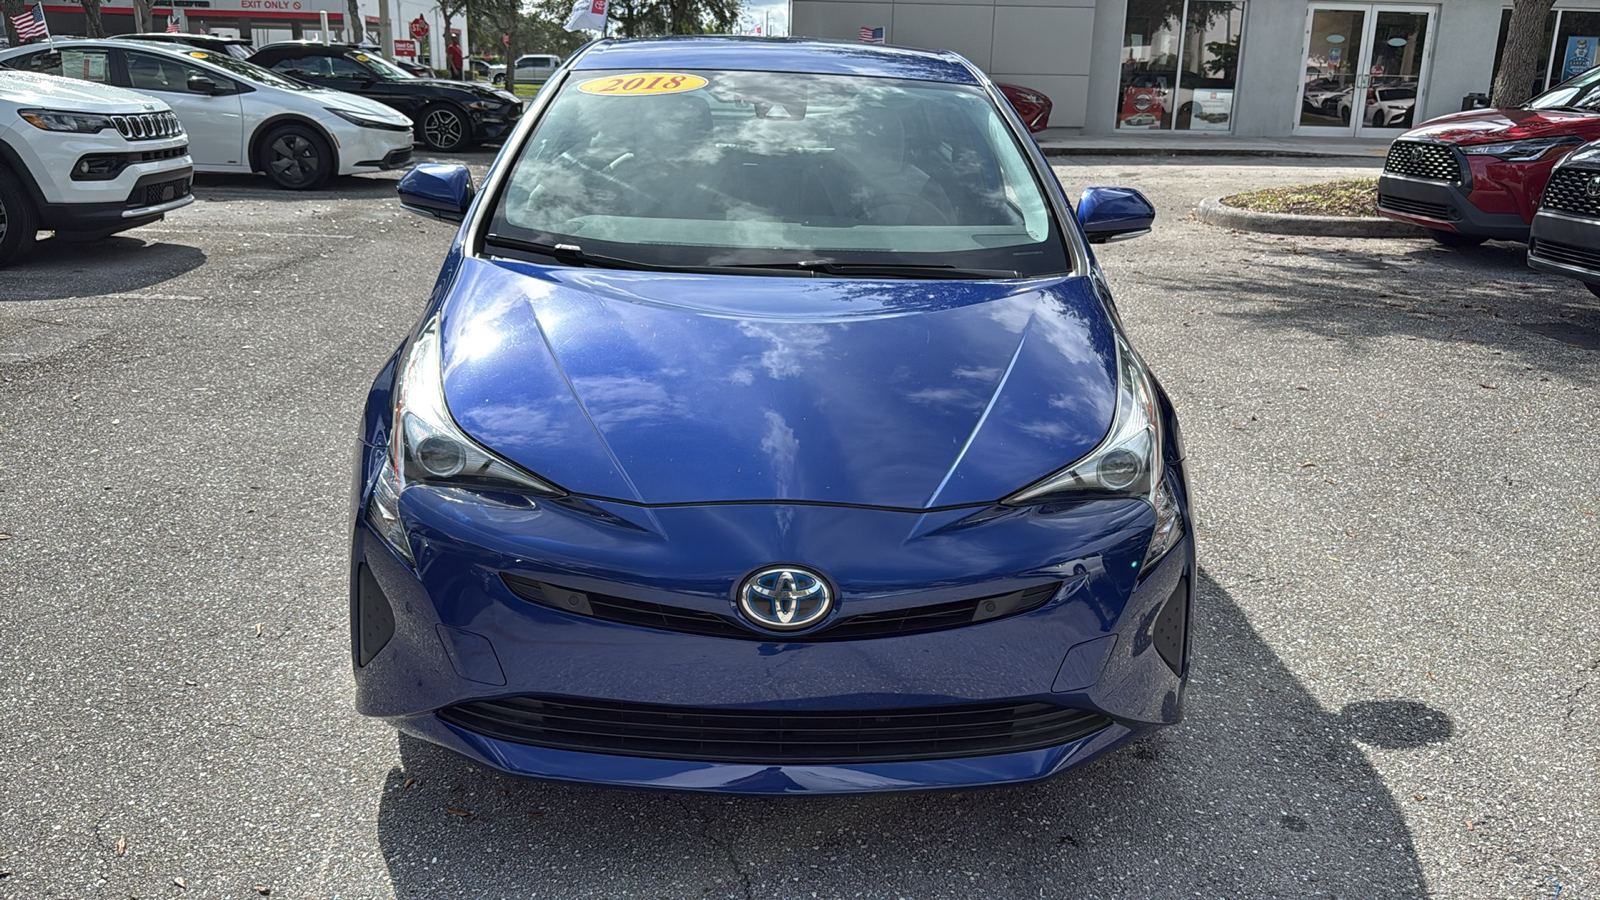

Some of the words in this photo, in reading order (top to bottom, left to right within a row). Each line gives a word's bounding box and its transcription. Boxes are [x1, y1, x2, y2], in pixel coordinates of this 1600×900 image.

[241, 0, 261, 8] EXIT
[264, 1, 289, 9] ONLY
[598, 76, 687, 92] 2018
